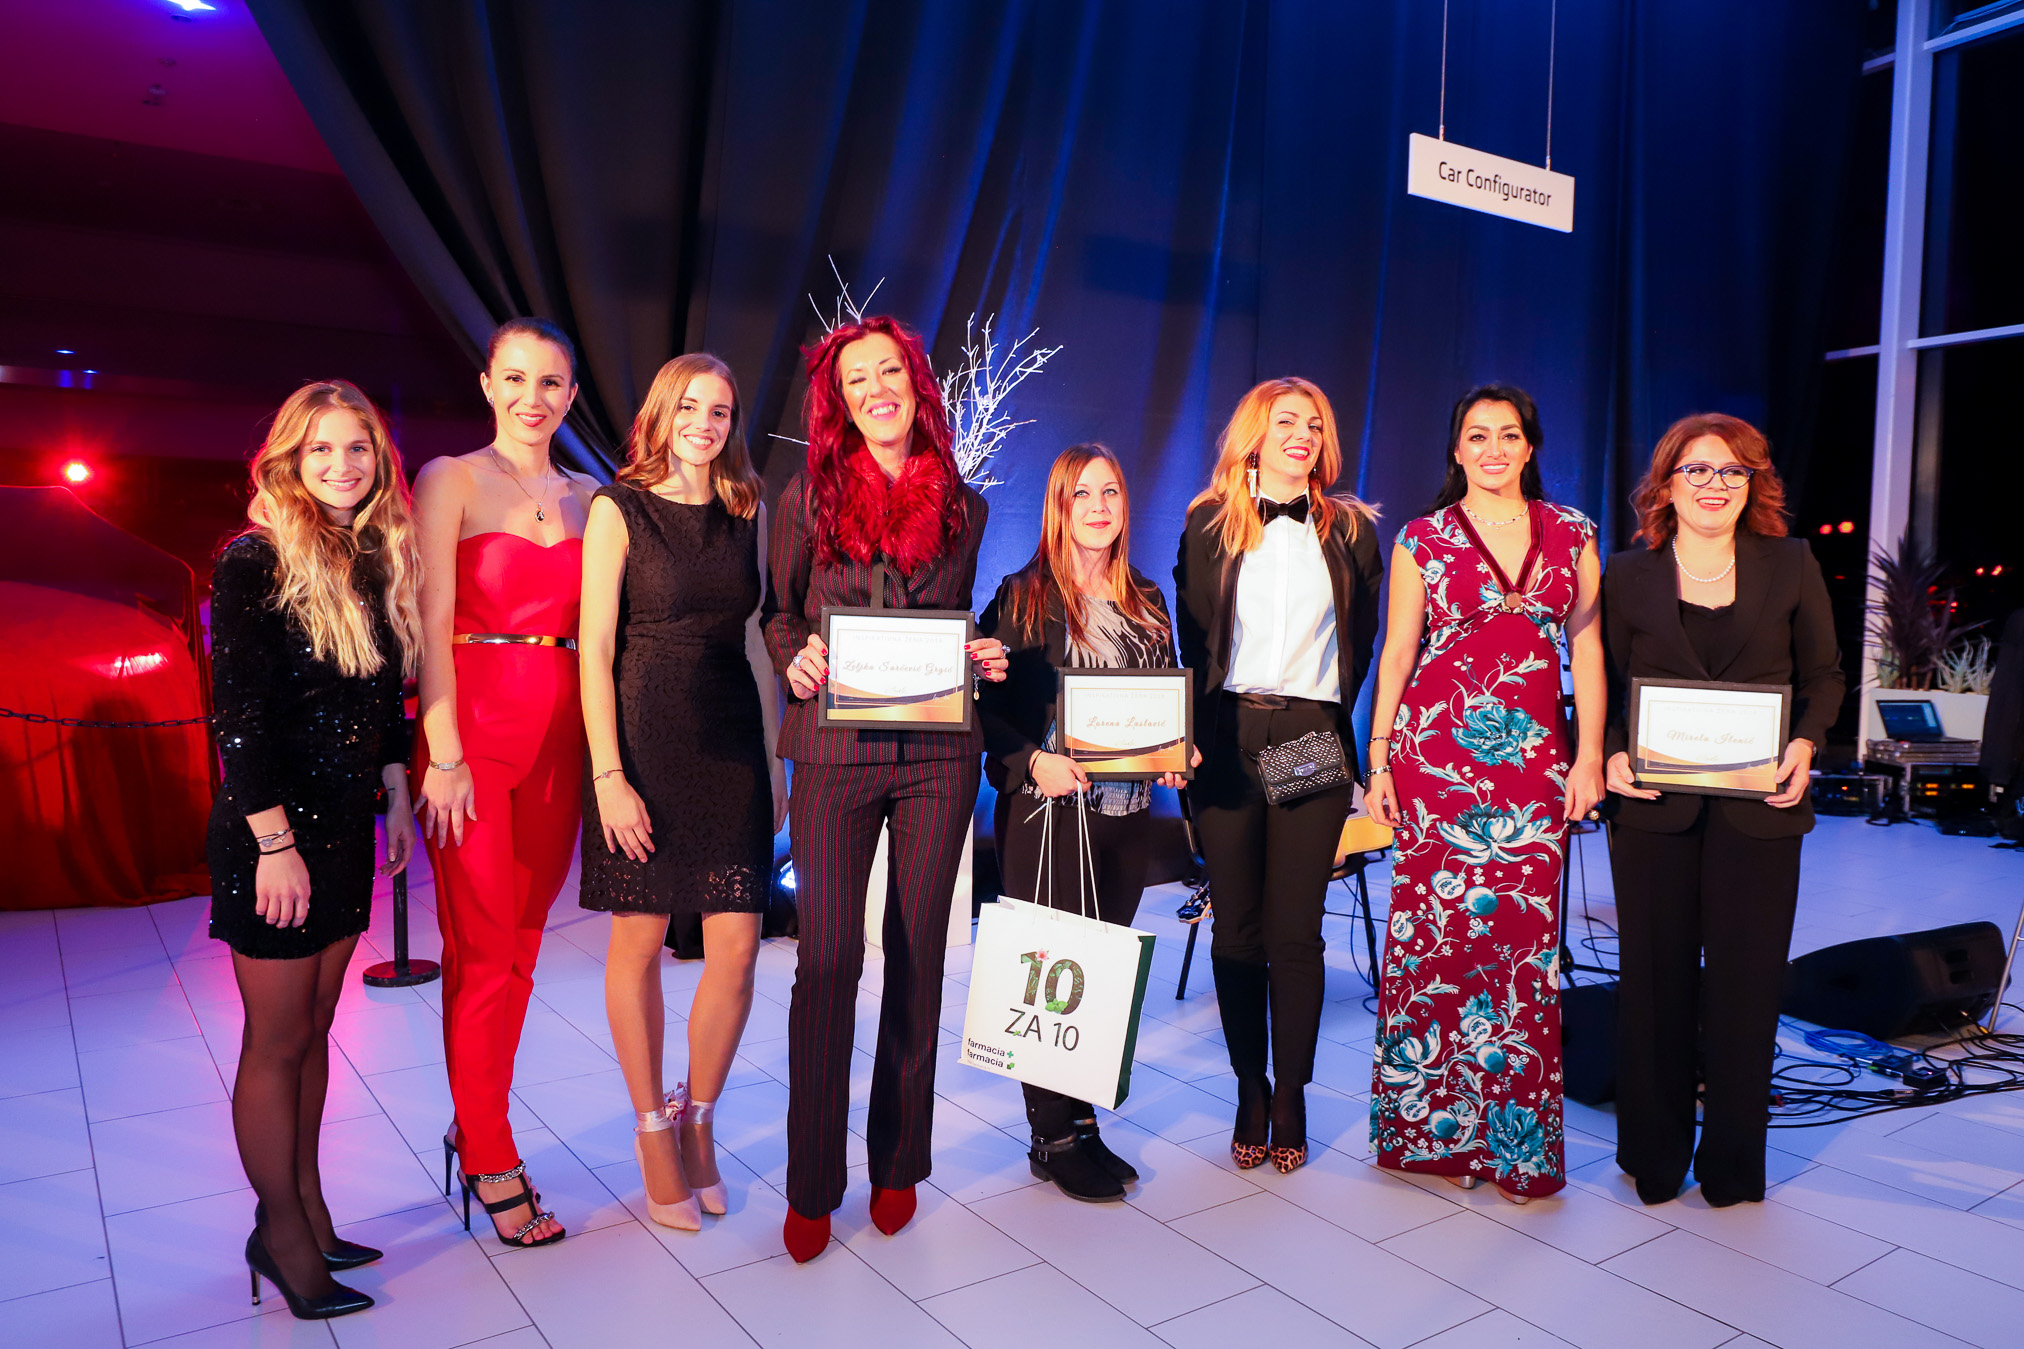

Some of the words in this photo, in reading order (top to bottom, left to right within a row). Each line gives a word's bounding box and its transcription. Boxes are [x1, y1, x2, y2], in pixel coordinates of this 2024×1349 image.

[1438, 161, 1462, 183] Car
[1466, 168, 1552, 207] Configurator
[1020, 951, 1085, 1015] 10
[967, 1037, 1005, 1057] farmacia
[1004, 1008, 1042, 1043] ZA
[1053, 1022, 1080, 1051] 10
[967, 1048, 1004, 1068] farmacia
